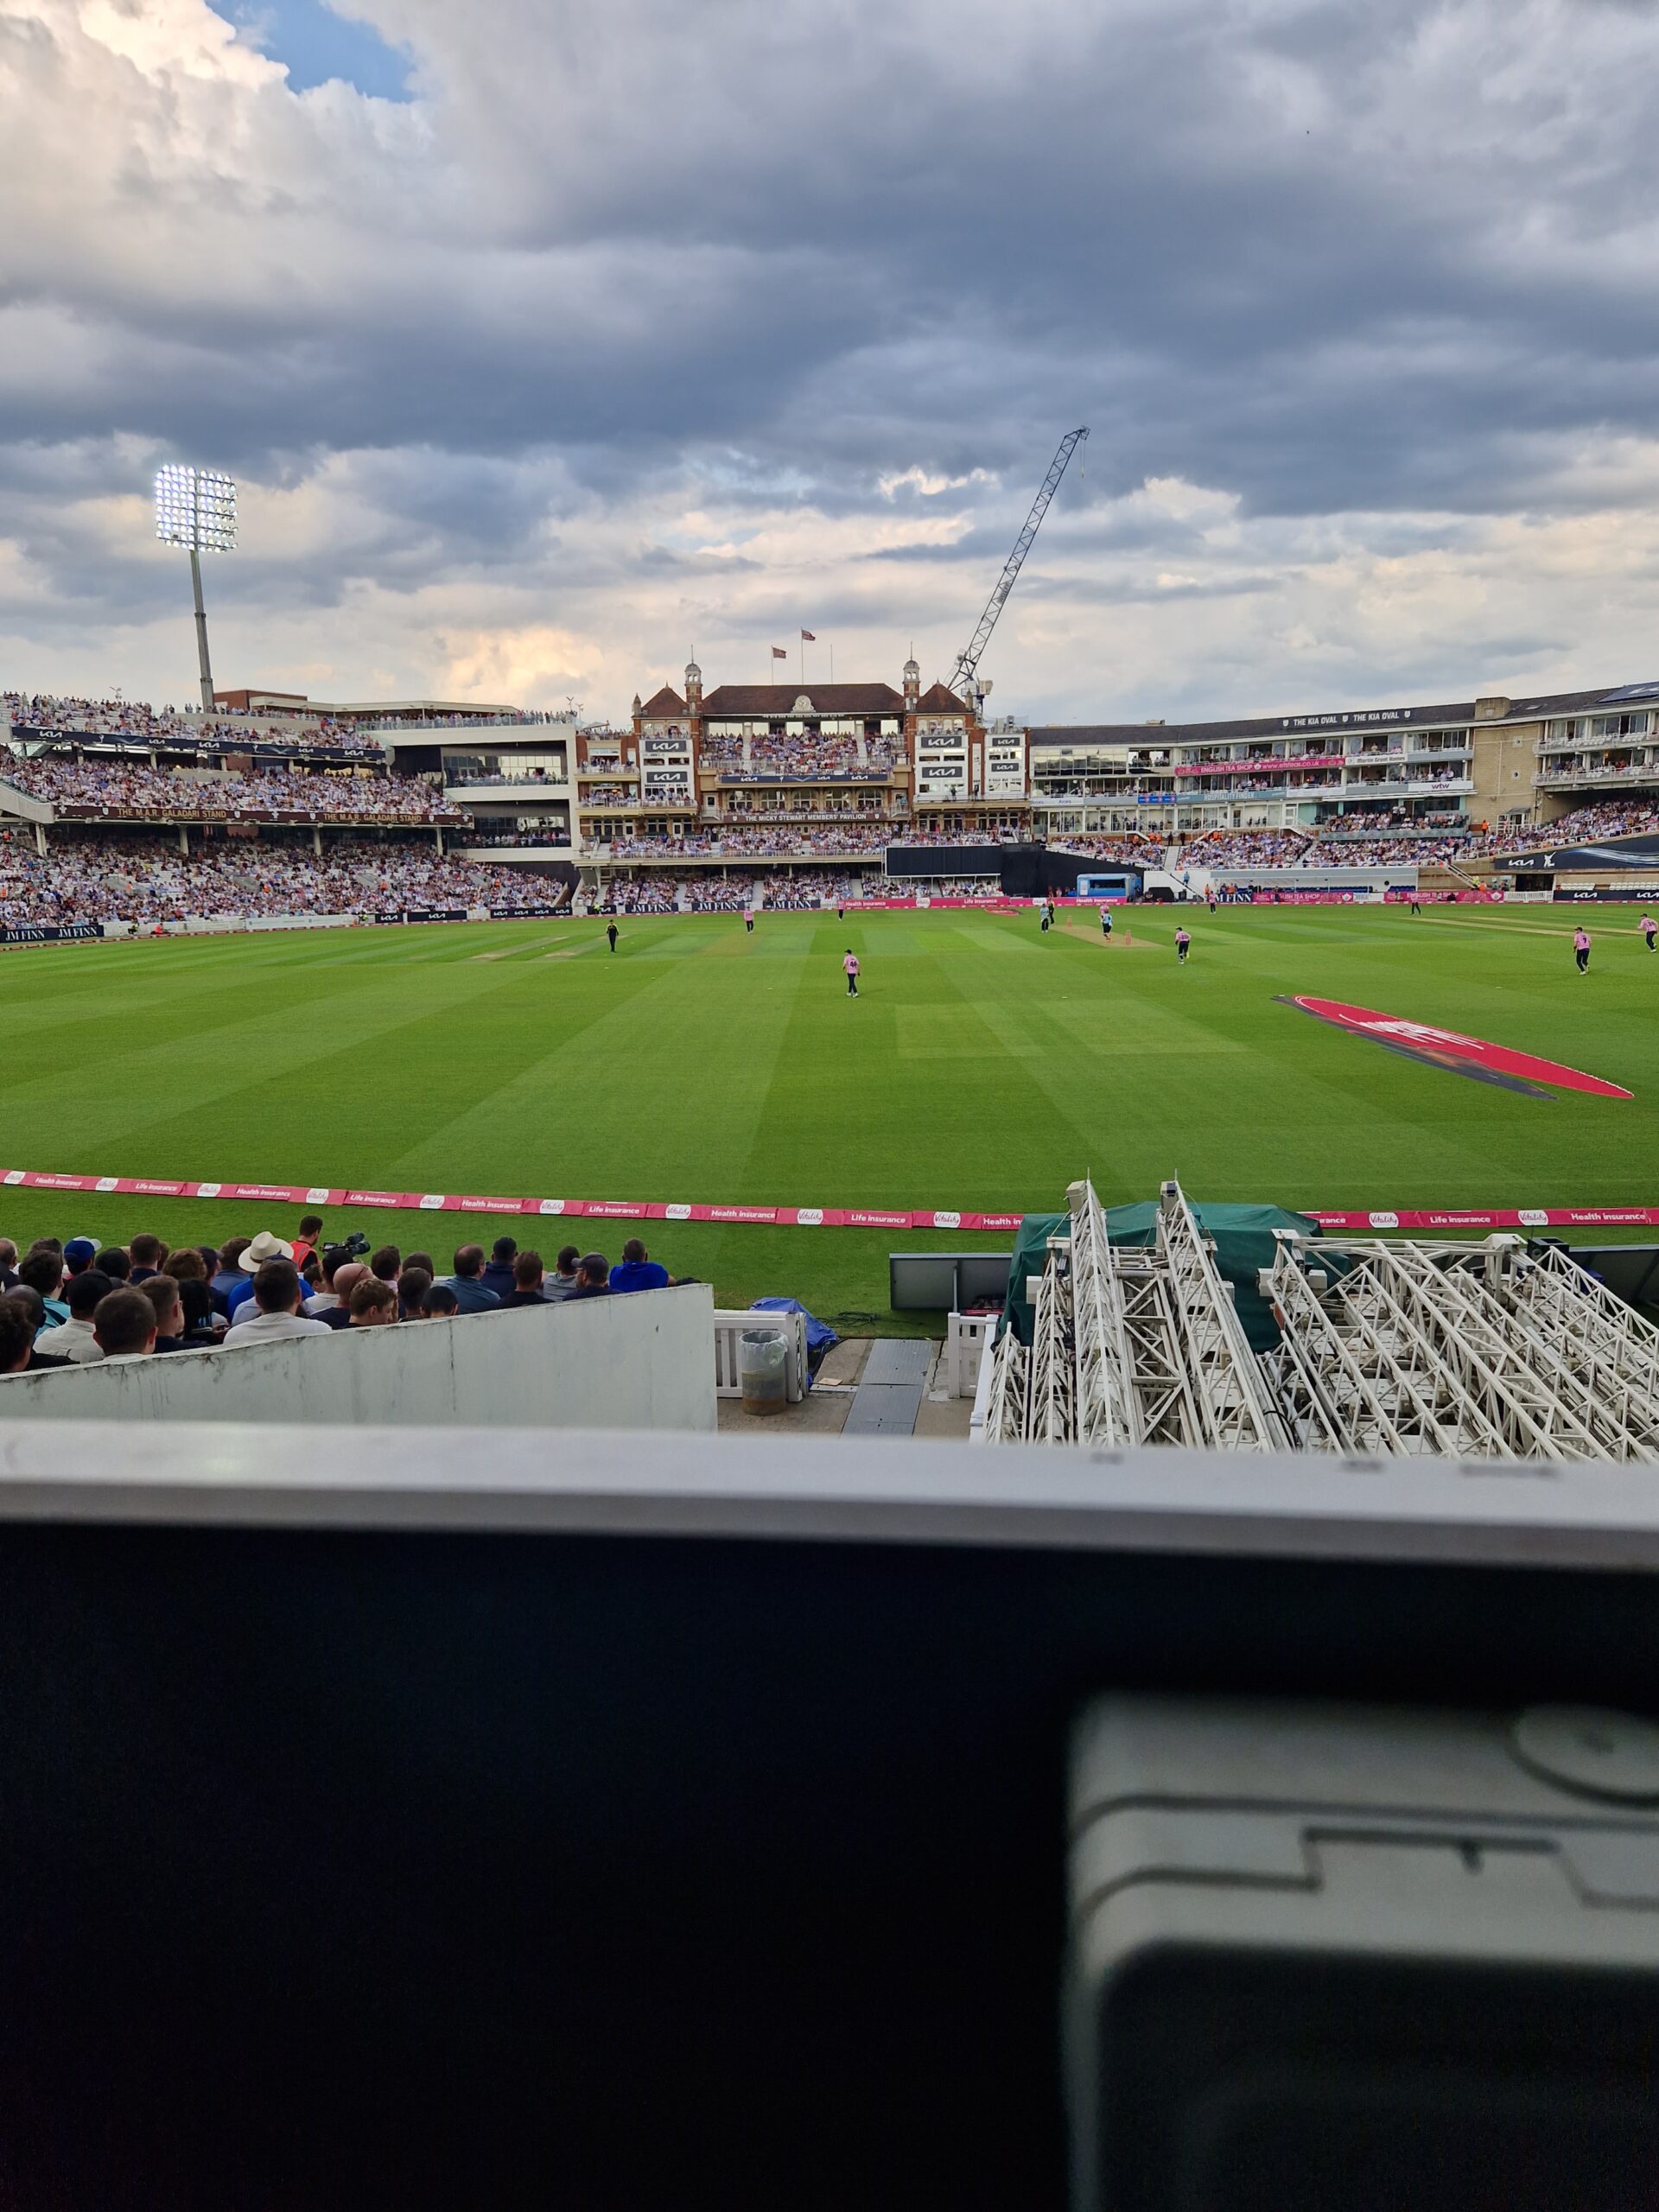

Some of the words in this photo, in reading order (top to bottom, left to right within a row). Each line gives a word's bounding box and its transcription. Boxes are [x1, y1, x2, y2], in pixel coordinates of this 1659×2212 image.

[1382, 711, 1399, 720] OVAL
[1201, 765, 1224, 773] ENGLISH
[118, 808, 133, 817] THE
[162, 809, 200, 817] GALADARI
[202, 810, 226, 818] STAND
[1508, 858, 1534, 867] KIA
[1226, 893, 1251, 902] FINN
[648, 903, 671, 912] FINN
[715, 901, 739, 910] FINN
[5, 931, 20, 941] JM
[22, 929, 45, 940] FINN
[58, 928, 71, 938] JM
[73, 926, 98, 937] FINN
[365, 1196, 397, 1205] insurance
[487, 1201, 521, 1210] insurance
[798, 1210, 822, 1221] Vitality
[868, 1215, 906, 1224] insurance
[935, 1213, 960, 1224] Vitality
[1370, 1213, 1398, 1225] Vitality
[1519, 1211, 1548, 1224] Vitality
[1603, 1212, 1645, 1221] insurance
[983, 1217, 1011, 1225] Health
